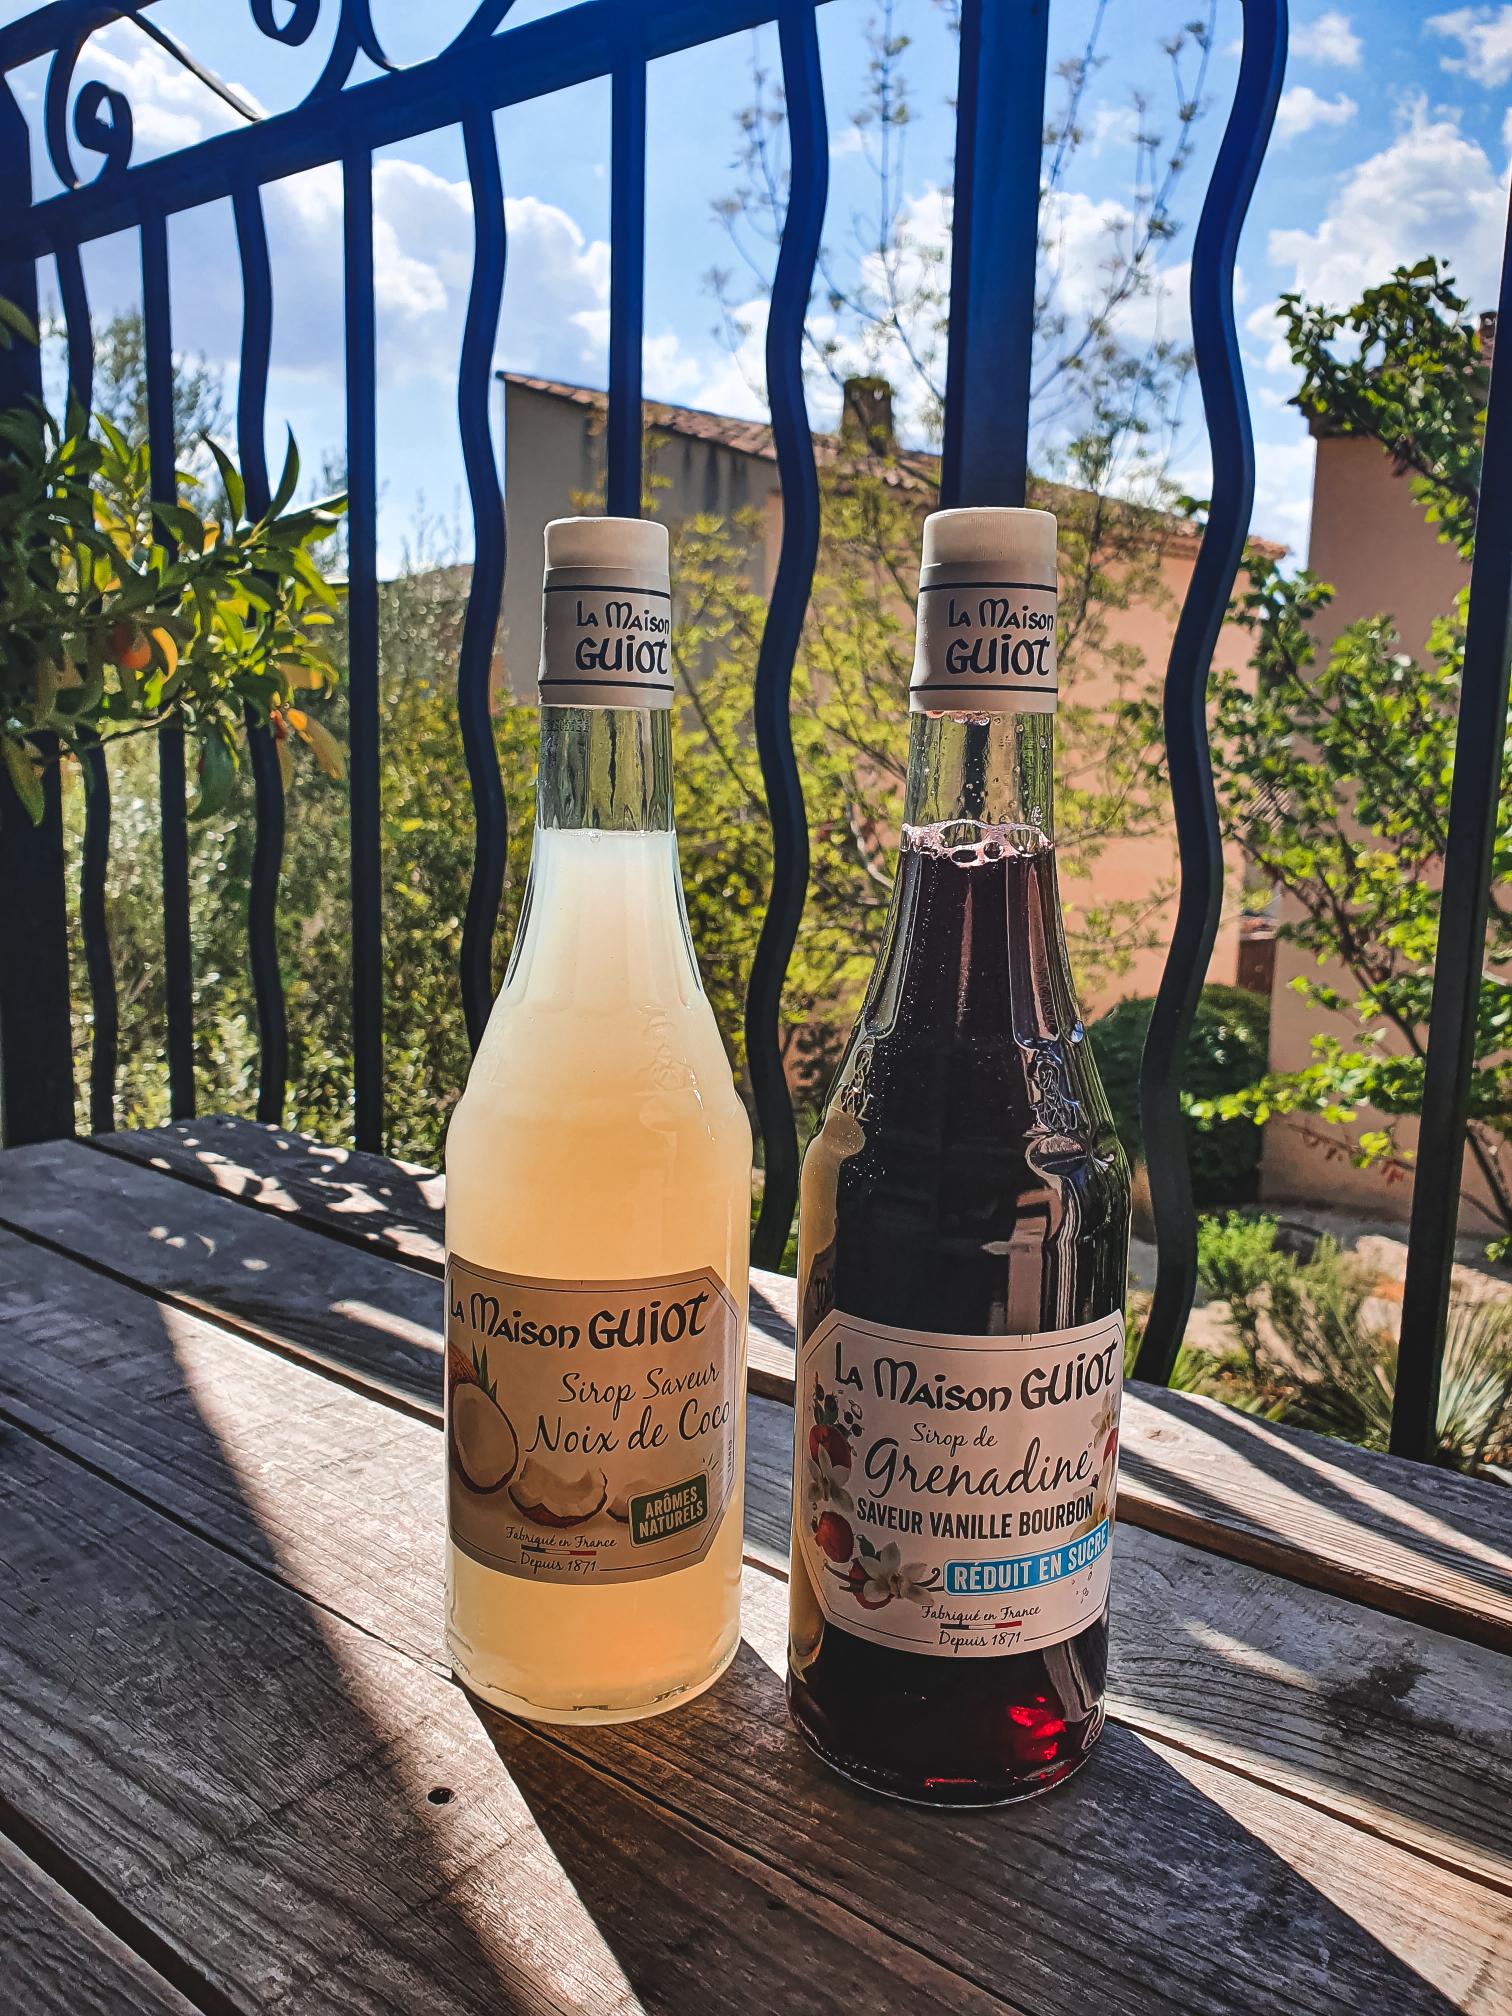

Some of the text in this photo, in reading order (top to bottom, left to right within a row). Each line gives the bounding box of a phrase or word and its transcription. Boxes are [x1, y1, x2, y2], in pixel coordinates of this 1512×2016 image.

[558, 1361, 720, 1422] Sirop Saveur
[525, 1397, 730, 1455] Noix de Coco
[910, 1422, 998, 1458] Sirop de
[639, 1500, 704, 1538] NATURELS
[645, 1486, 698, 1519] ARÔMES
[856, 1492, 1094, 1540] SAVEUR VANILLE BOURBON
[505, 1526, 617, 1549] Fabriqué en France
[520, 1551, 597, 1575] Depuis 1871
[954, 1557, 1031, 1591] RÉDUIT
[1040, 1552, 1062, 1581] EN
[921, 1604, 1042, 1626] Fabriqué en France
[938, 1629, 1022, 1654] Depuis 1871
